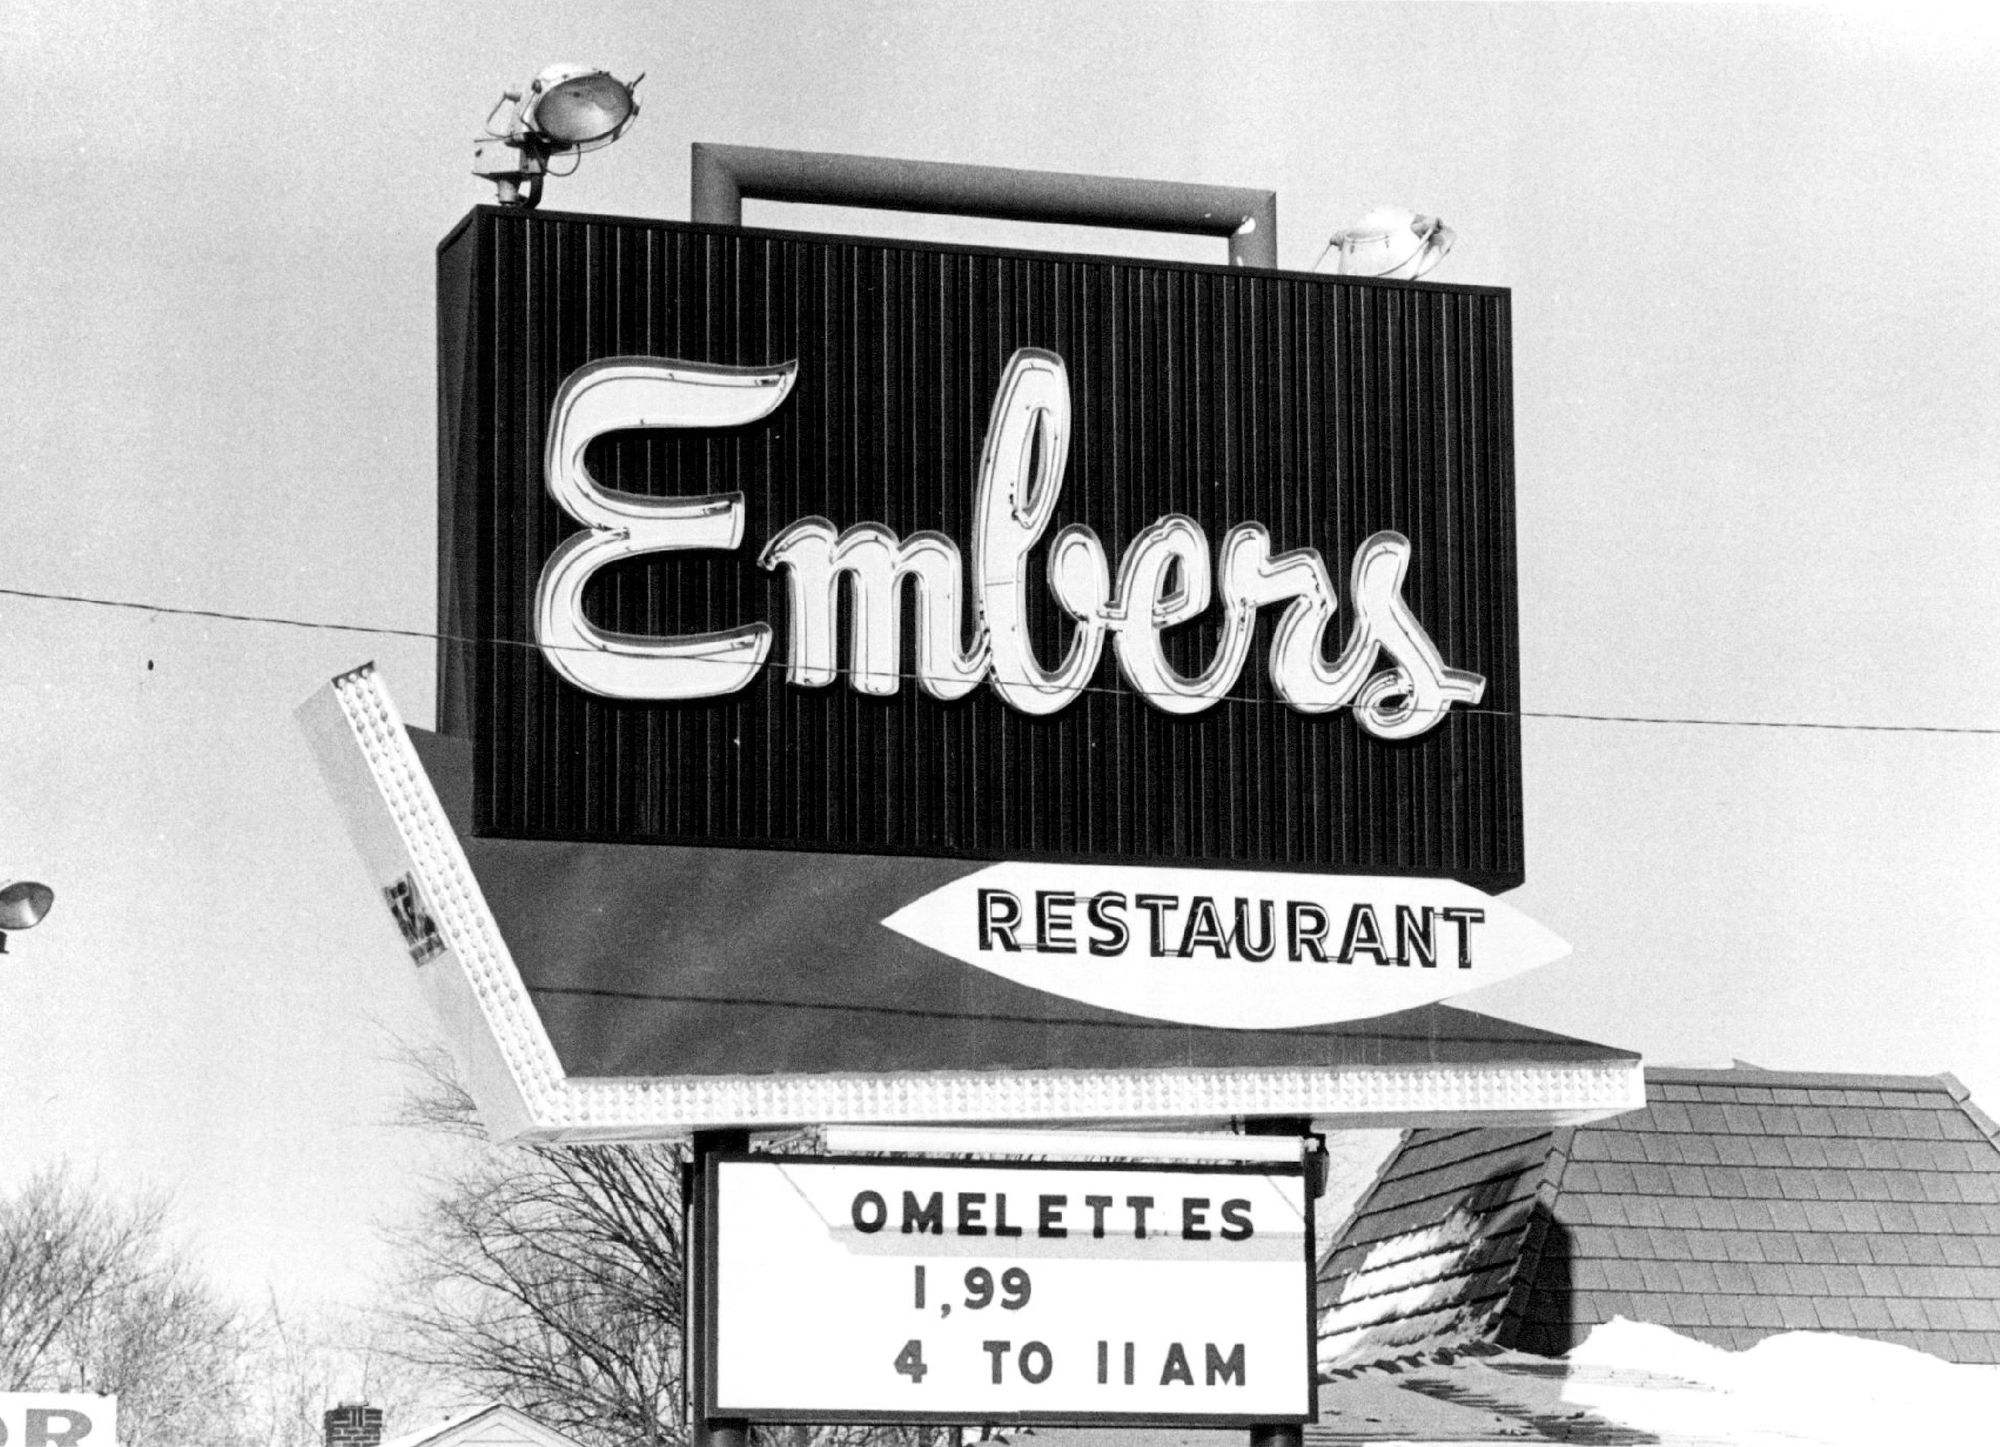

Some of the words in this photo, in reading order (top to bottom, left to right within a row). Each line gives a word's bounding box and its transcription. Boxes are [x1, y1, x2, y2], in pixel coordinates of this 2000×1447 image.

[534, 347, 1486, 741] Embers
[977, 887, 1485, 970] RESTAURANT
[851, 1189, 1254, 1242] OMELETTES
[894, 1339, 928, 1384] 4
[983, 1340, 1053, 1385] TO
